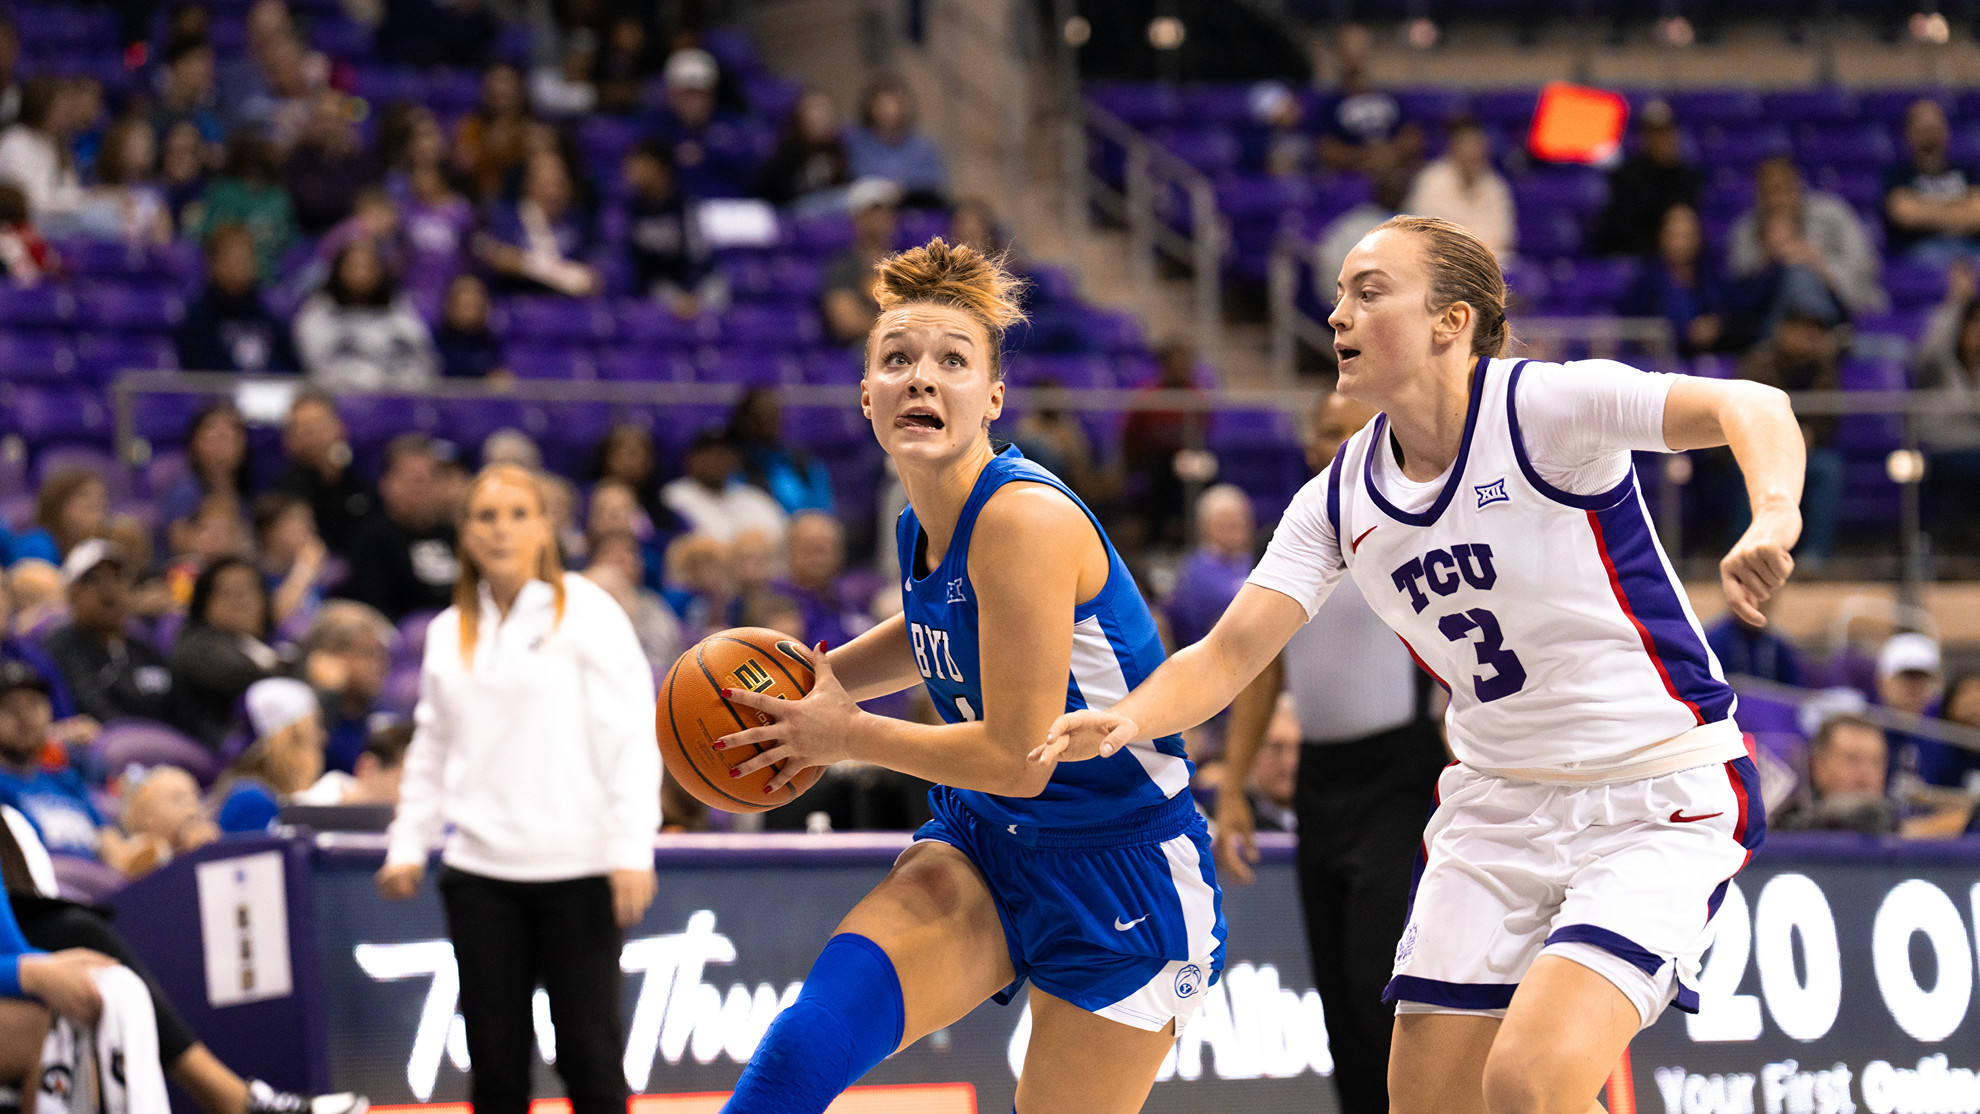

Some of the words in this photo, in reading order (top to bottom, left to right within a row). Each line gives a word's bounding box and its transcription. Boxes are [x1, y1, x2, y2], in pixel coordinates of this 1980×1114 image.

[1391, 543, 1497, 615] TCU
[1438, 608, 1527, 704] 3
[1685, 873, 1842, 1043] 20
[1872, 878, 1980, 1043] O
[1654, 1065, 1757, 1114] Your
